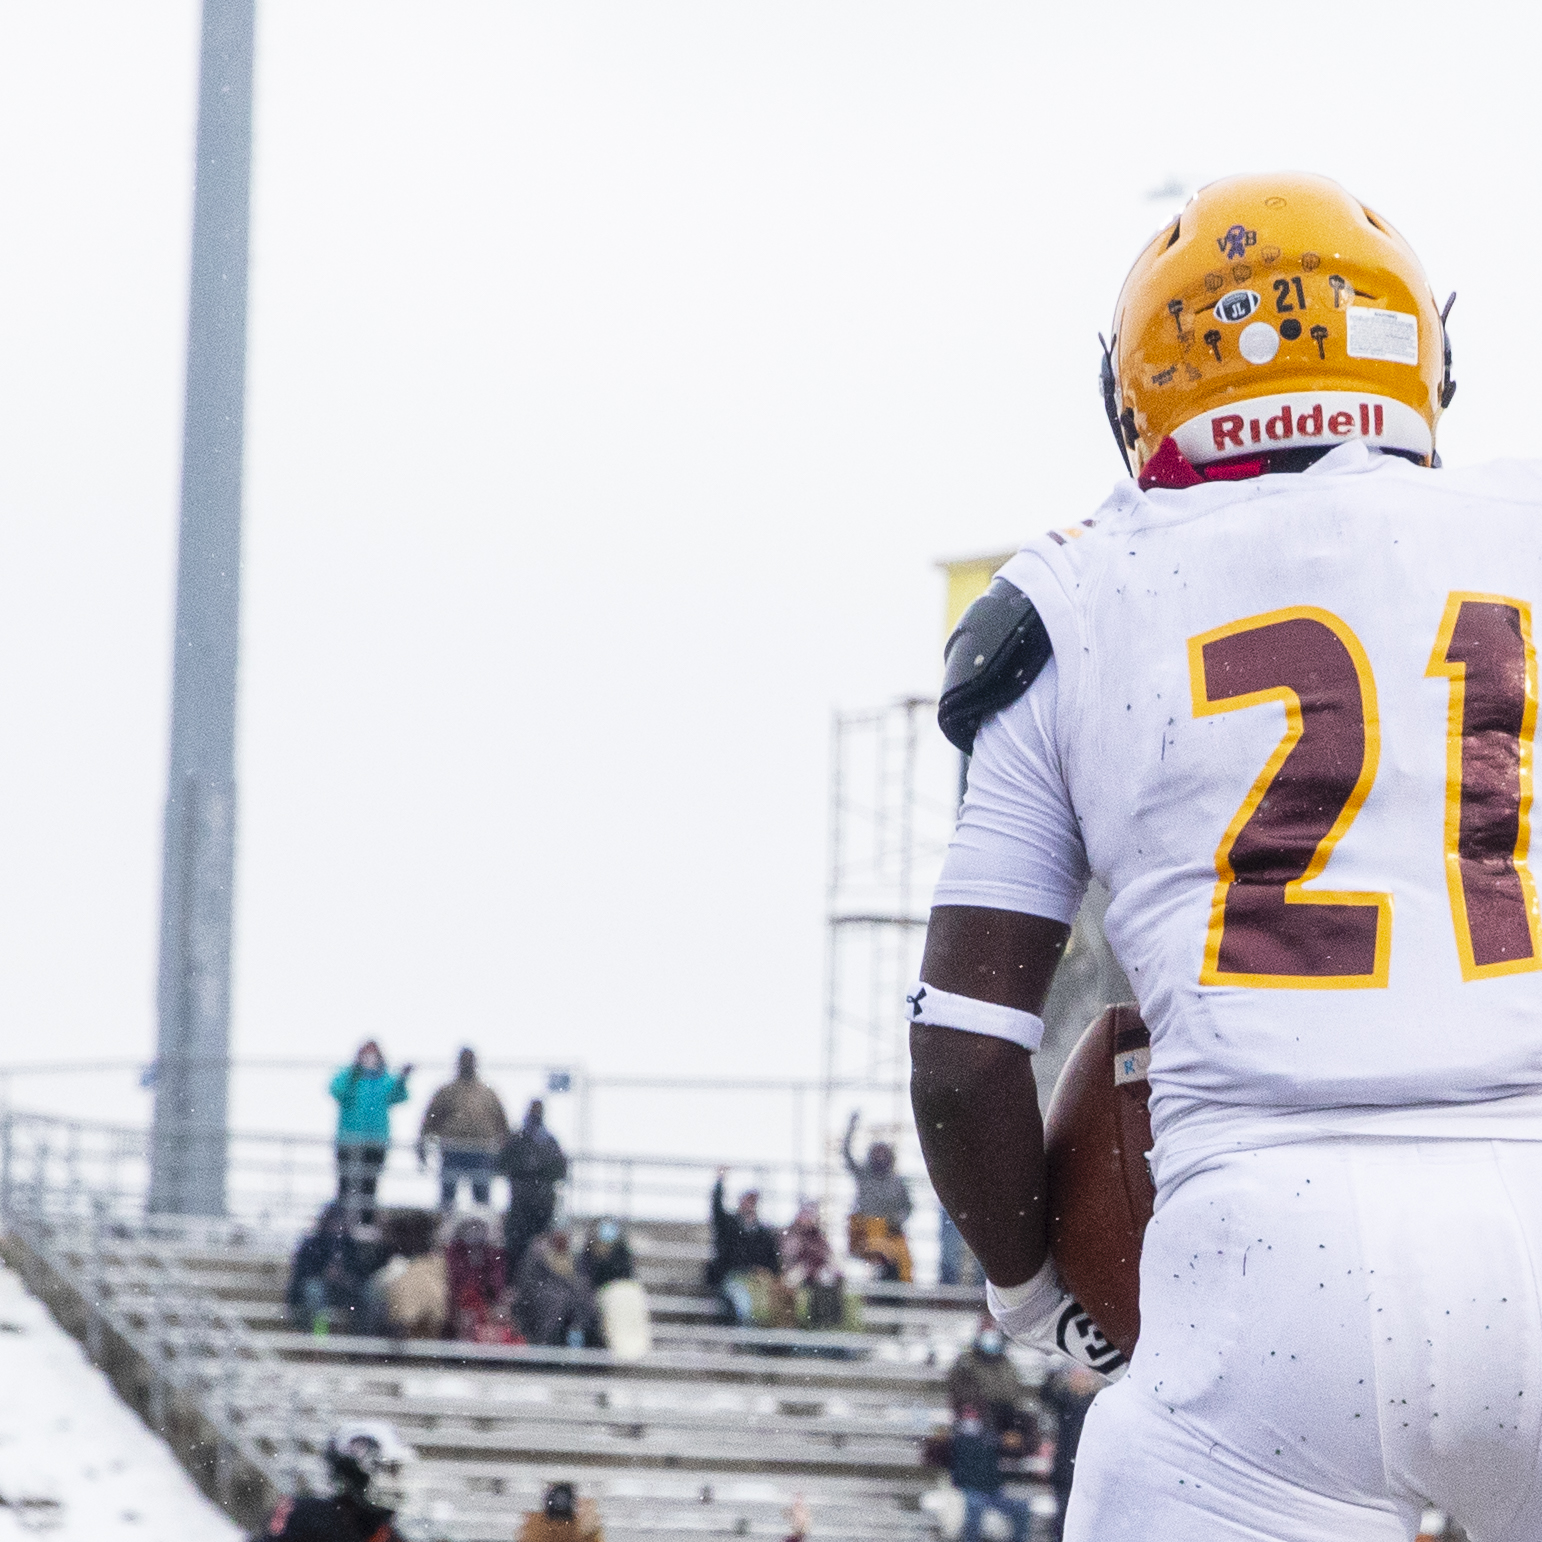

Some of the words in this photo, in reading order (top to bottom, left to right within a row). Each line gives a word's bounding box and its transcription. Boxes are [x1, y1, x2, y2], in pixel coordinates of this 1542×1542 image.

[1231, 302, 1247, 319] JL
[1272, 275, 1307, 313] 21
[1210, 402, 1384, 451] Riddell
